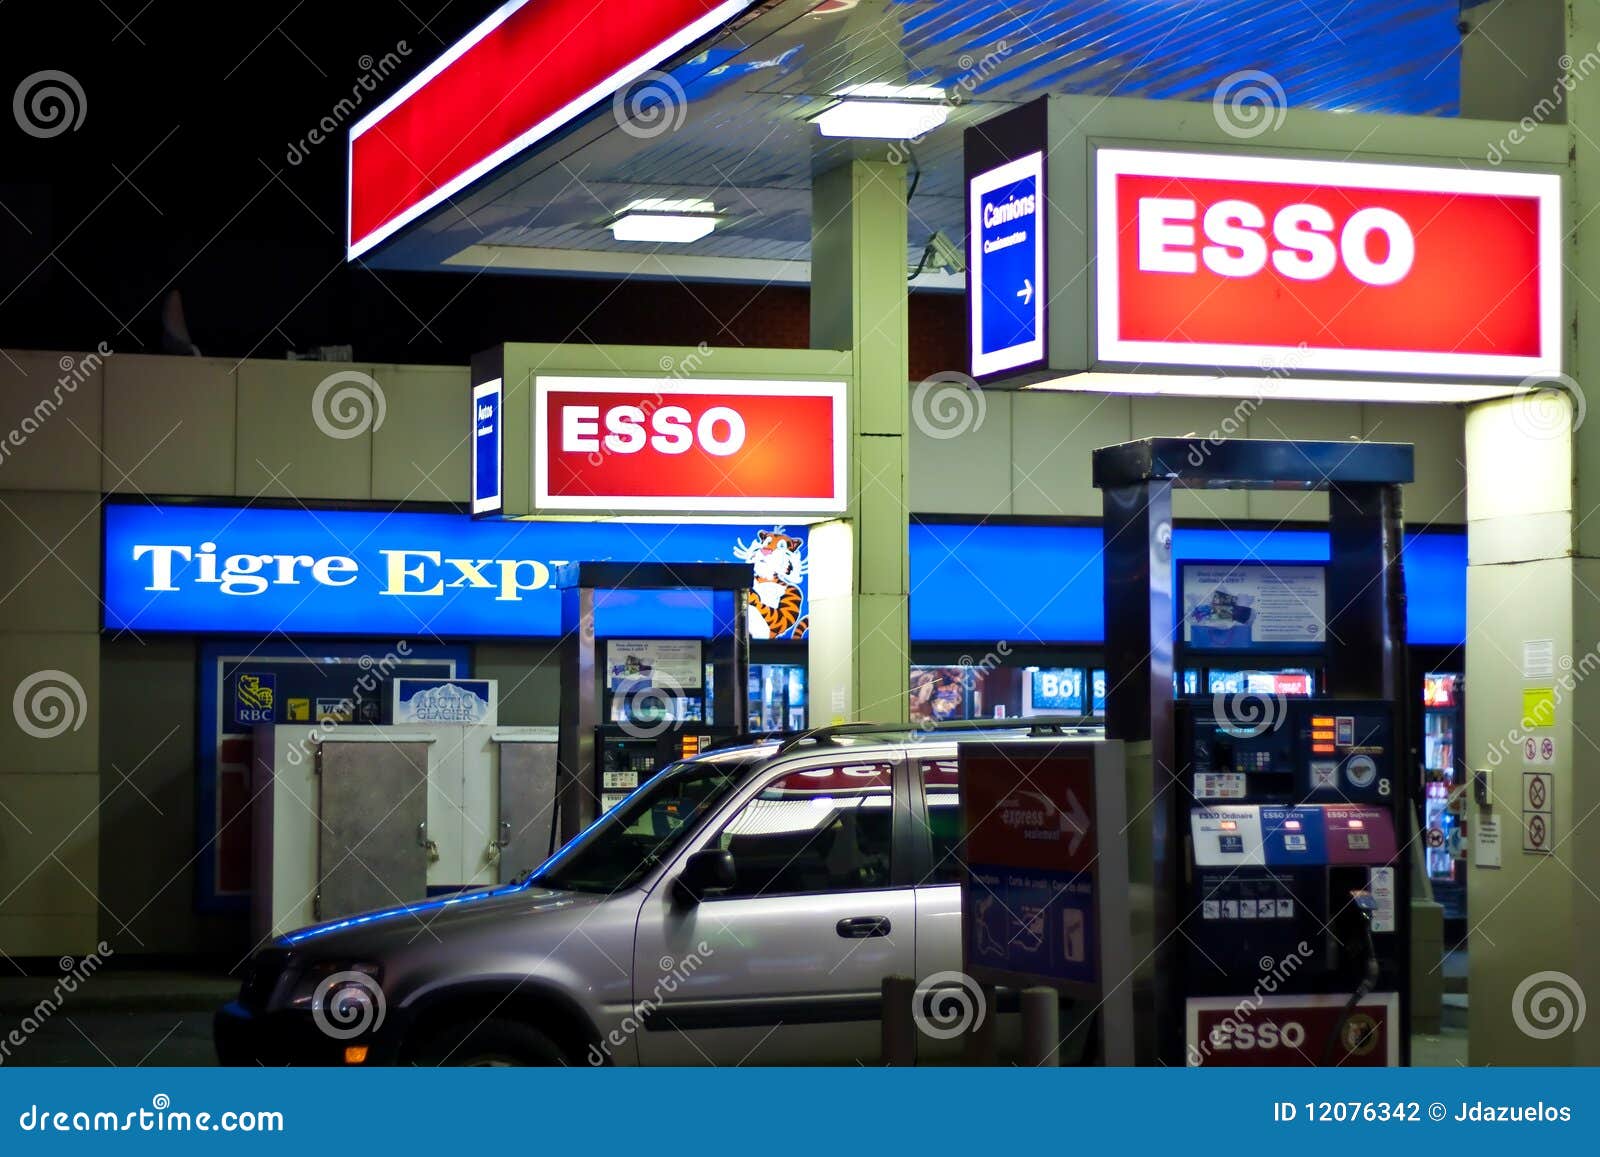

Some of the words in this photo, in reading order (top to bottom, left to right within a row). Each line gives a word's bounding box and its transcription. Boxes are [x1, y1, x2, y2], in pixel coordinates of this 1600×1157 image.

[984, 194, 1035, 229] Camions
[1137, 196, 1416, 286] ESSO
[562, 405, 747, 456] ESSO
[133, 541, 359, 596] Tigre
[240, 709, 272, 721] RBC
[416, 694, 473, 709] ARCTIC
[416, 708, 472, 720] GLACIER
[1378, 778, 1391, 795] 8
[1212, 1022, 1305, 1050] ESSO
